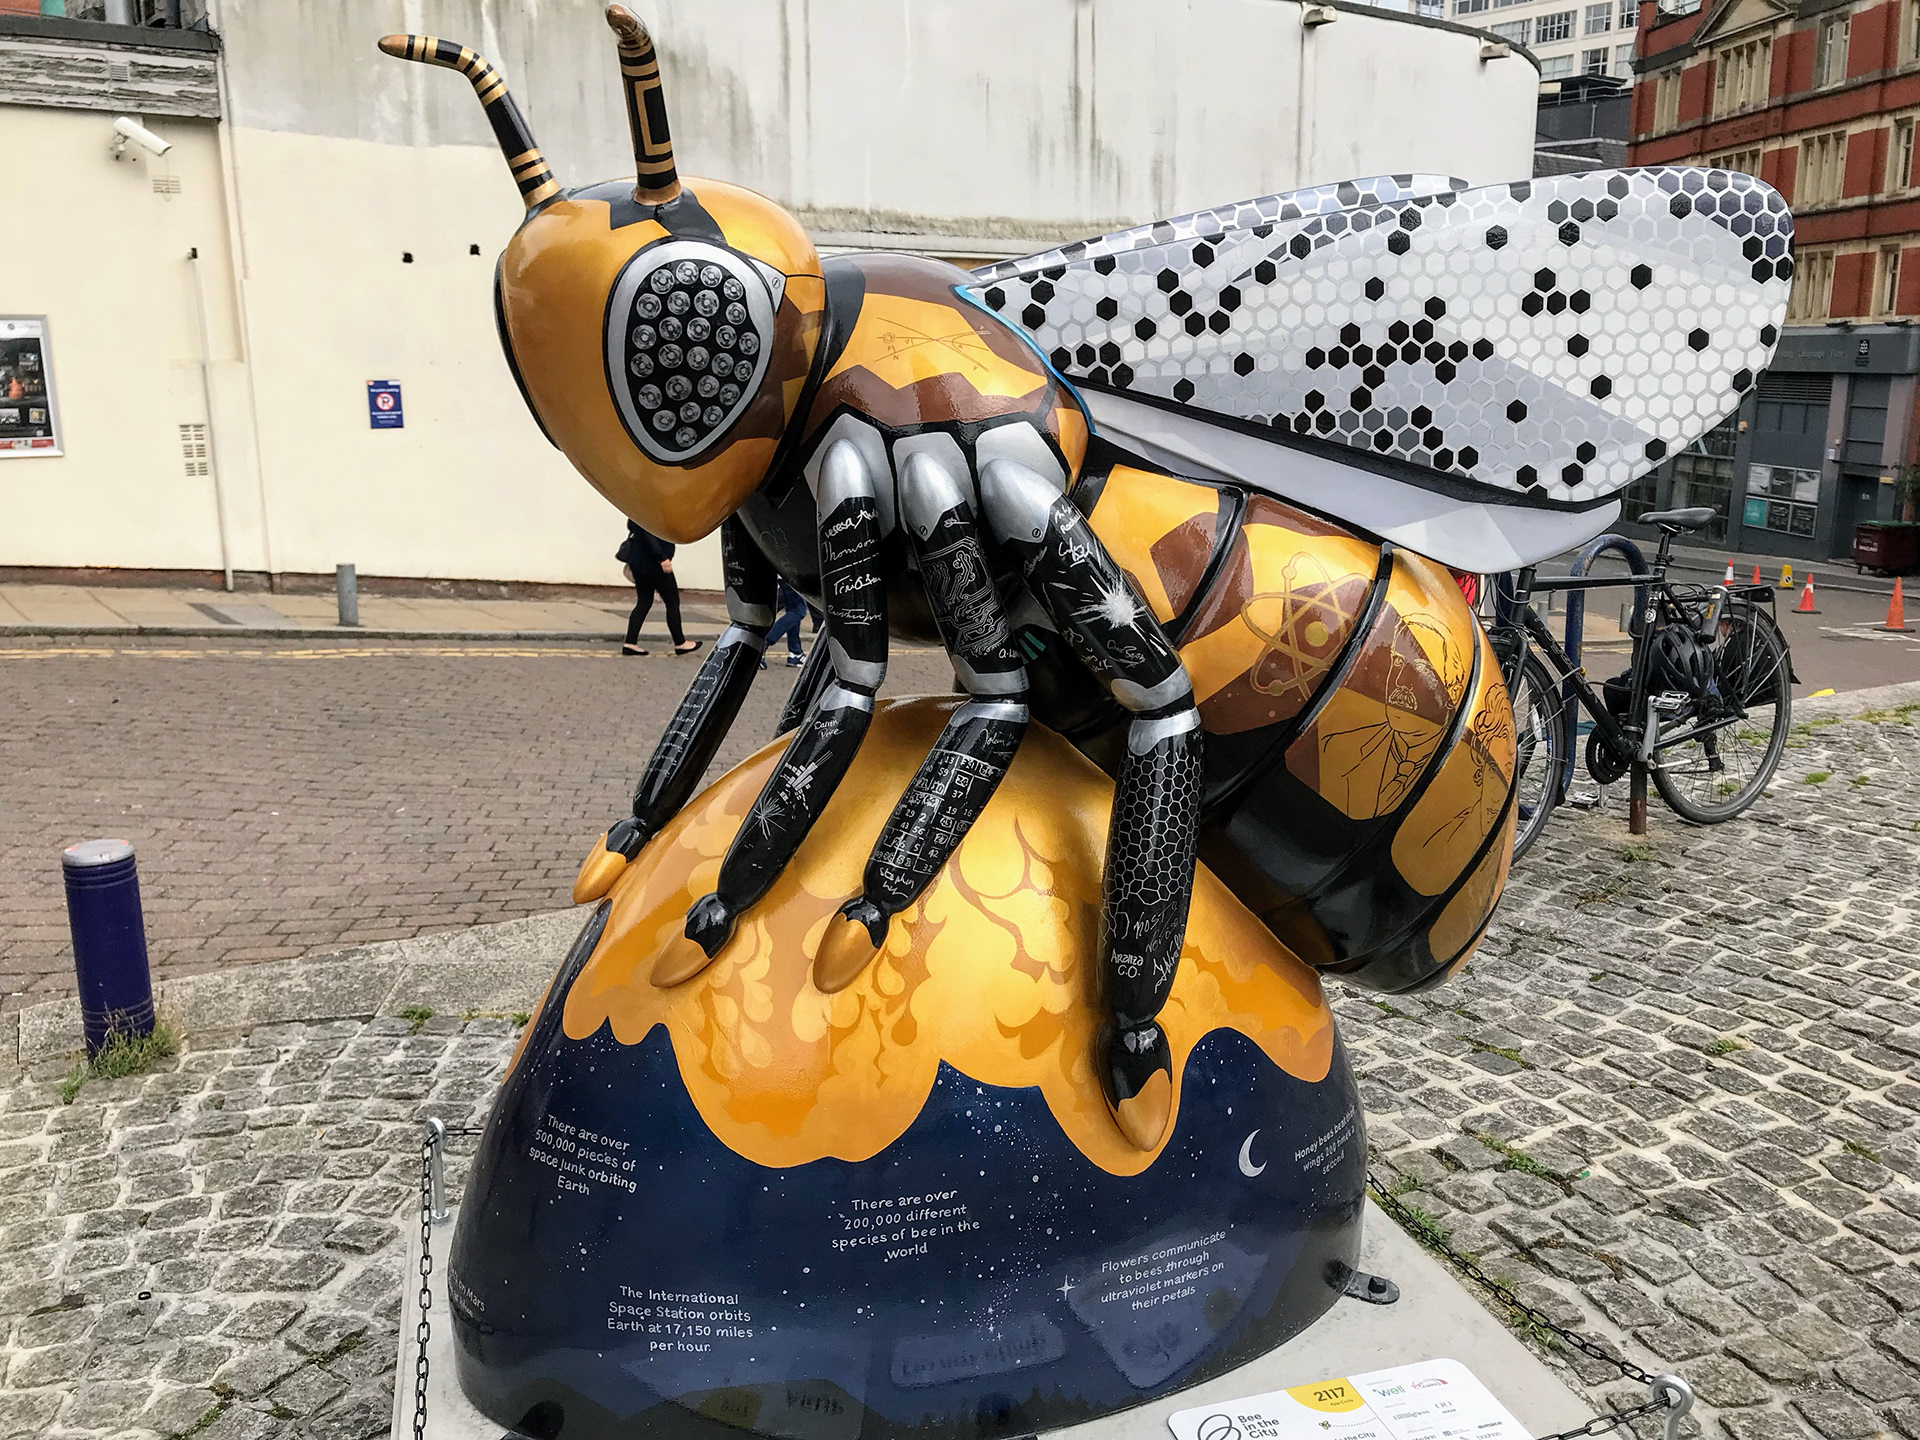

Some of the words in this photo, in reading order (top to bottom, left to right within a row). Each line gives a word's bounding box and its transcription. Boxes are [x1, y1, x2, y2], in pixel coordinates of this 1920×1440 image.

[952, 790, 964, 798] 37
[946, 806, 958, 815] 19
[912, 826, 926, 835] 56
[548, 1114, 576, 1135] There
[578, 1128, 598, 1143] are
[600, 1136, 630, 1151] over
[535, 1129, 576, 1153] 500,000
[577, 1147, 618, 1168] pieces
[622, 1160, 637, 1172] of
[1294, 1140, 1318, 1162] Honey
[1318, 1128, 1334, 1146] bees
[529, 1147, 558, 1168] space
[558, 1158, 586, 1176] junk
[588, 1169, 638, 1193] orbiting
[1303, 1152, 1325, 1172] wings
[1322, 1150, 1345, 1174] second
[557, 1175, 590, 1196] Earth
[852, 1199, 894, 1212] There
[898, 1196, 922, 1207] are
[925, 1190, 958, 1203] over
[844, 1213, 902, 1230] 200,000
[906, 1204, 968, 1222] different
[832, 1233, 888, 1252] species
[891, 1228, 906, 1242] of
[911, 1226, 937, 1239] bee
[940, 1223, 954, 1236] in
[958, 1220, 981, 1232] the
[886, 1242, 928, 1260] world
[1102, 1254, 1149, 1273] Flowers
[1151, 1230, 1226, 1260] communicate
[1119, 1273, 1132, 1284] to
[1134, 1266, 1162, 1280] bees
[1164, 1250, 1210, 1273] through
[1100, 1280, 1162, 1303] ultraviolet
[1164, 1266, 1210, 1288] markers
[1212, 1261, 1224, 1272] on
[466, 1288, 486, 1312] Mars
[620, 1285, 643, 1299] The
[648, 1288, 739, 1305] International
[1131, 1296, 1160, 1311] their
[1162, 1285, 1196, 1304] petals
[609, 1301, 652, 1317] Space
[656, 1306, 705, 1320] Station
[709, 1309, 752, 1322] orbits
[607, 1318, 645, 1332] Earth
[648, 1323, 662, 1334] at
[664, 1323, 712, 1338] 17,150
[716, 1326, 754, 1338] miles
[650, 1340, 674, 1352] per
[1313, 1386, 1345, 1402] 2117
[1237, 1412, 1262, 1424] Bee
[1244, 1423, 1256, 1432] in
[1256, 1418, 1280, 1430] the
[1249, 1427, 1279, 1440] City
[1358, 1431, 1376, 1440] City
